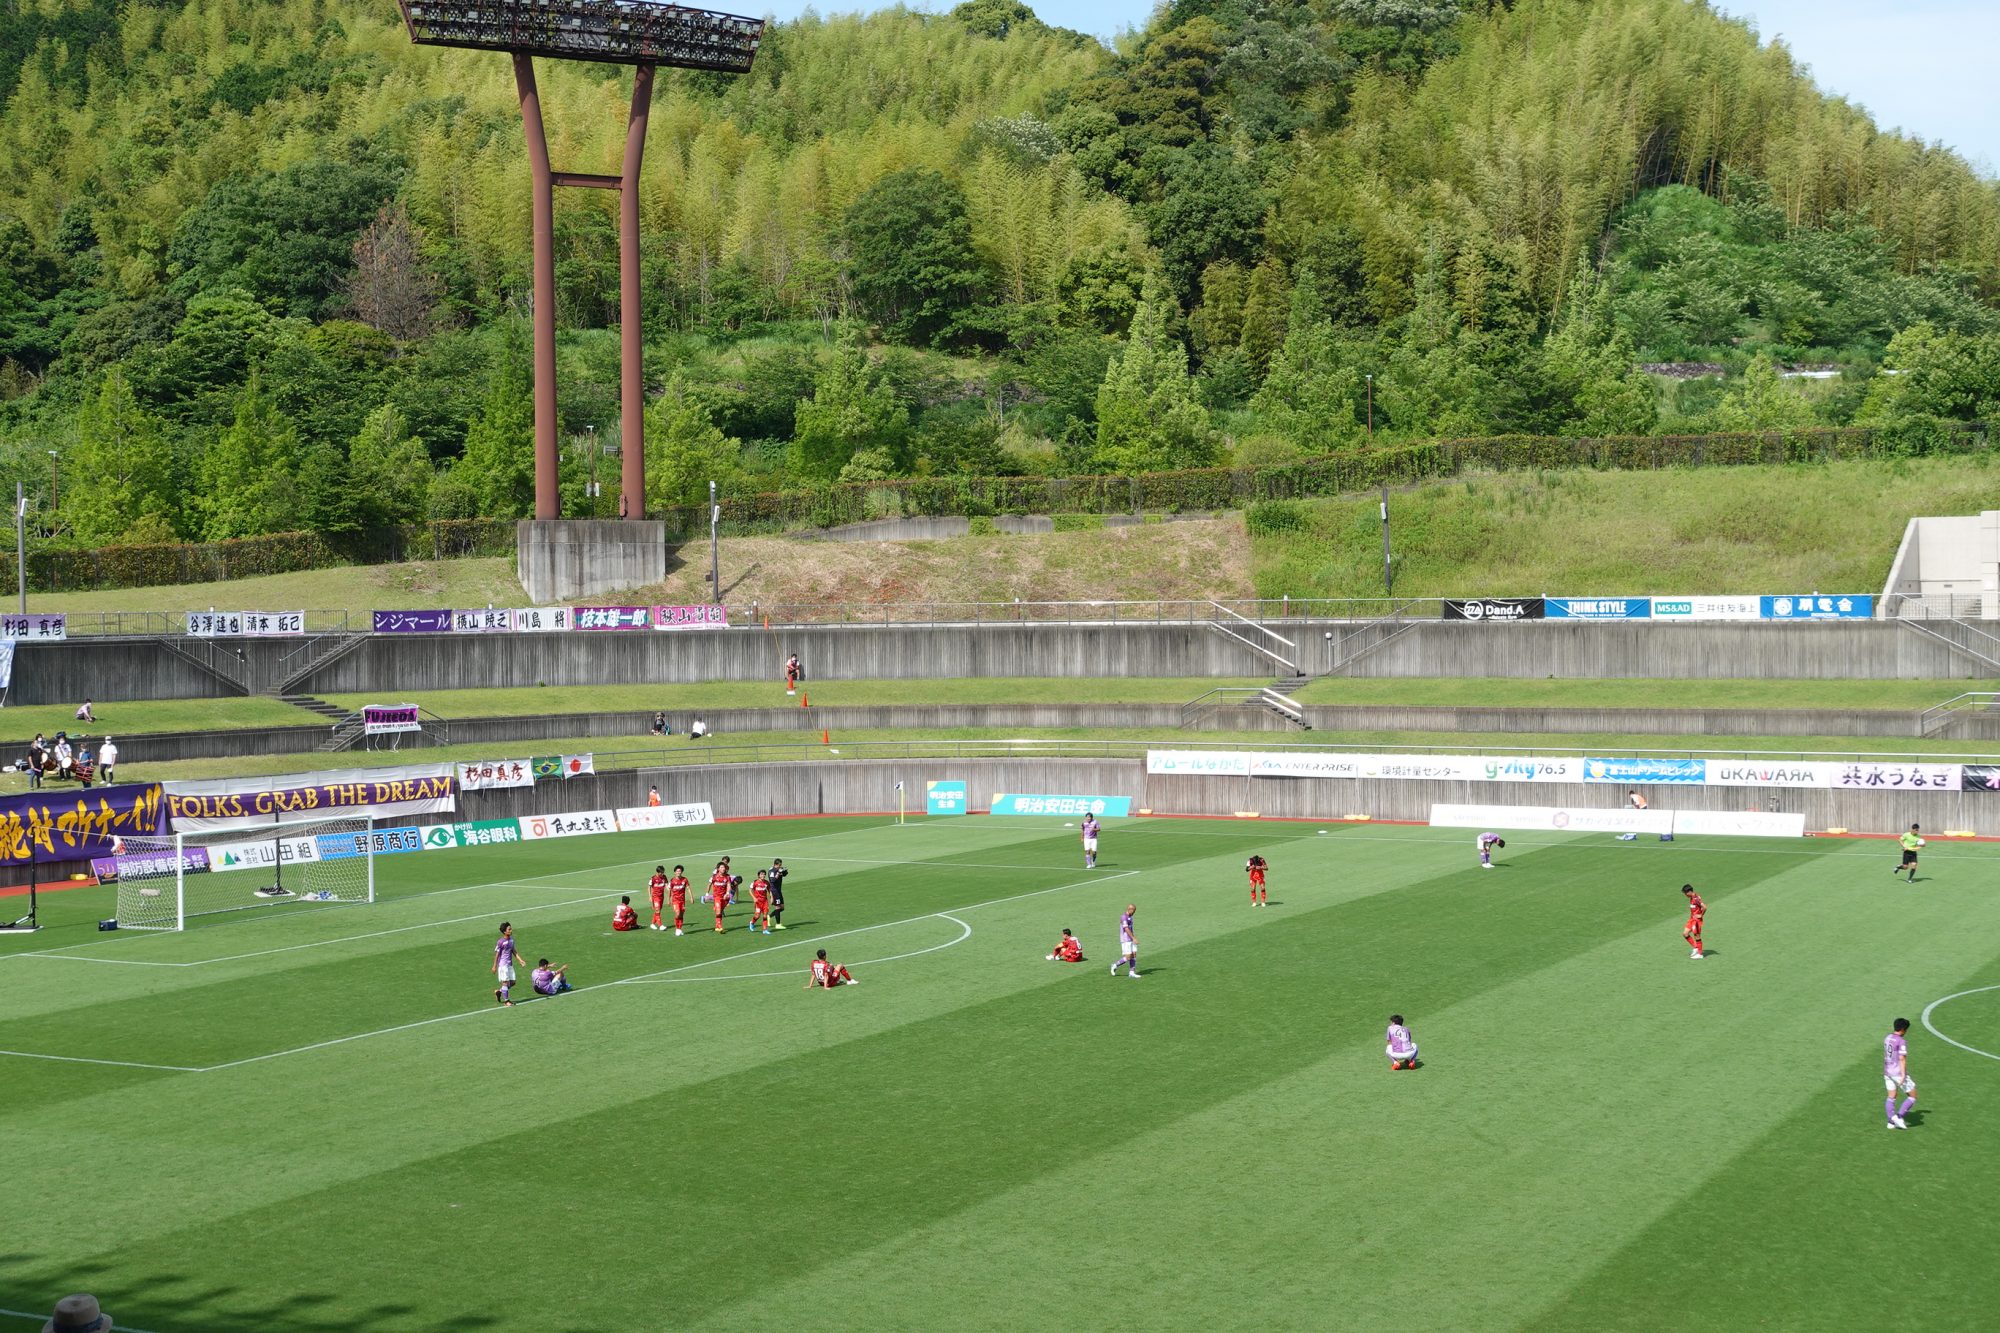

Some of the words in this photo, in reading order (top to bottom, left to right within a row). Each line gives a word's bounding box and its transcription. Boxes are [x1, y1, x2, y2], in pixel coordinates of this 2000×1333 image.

[1568, 601, 1598, 613] THINK
[1599, 601, 1626, 613] STYLE
[1656, 604, 1690, 612] MS&AD
[375, 612, 450, 630] シジマール
[1285, 762, 1355, 772] ENTERPRISE
[1537, 763, 1566, 775] 76.5
[1842, 765, 1952, 787] 共水うなぎ
[169, 795, 248, 818] FOLKS,
[255, 788, 318, 813] GRAB
[323, 783, 367, 806] THE
[374, 776, 451, 803] DREAM
[1013, 797, 1107, 814] 明治安田生命
[673, 807, 706, 823] 東ポリ
[814, 969, 825, 980] 18
